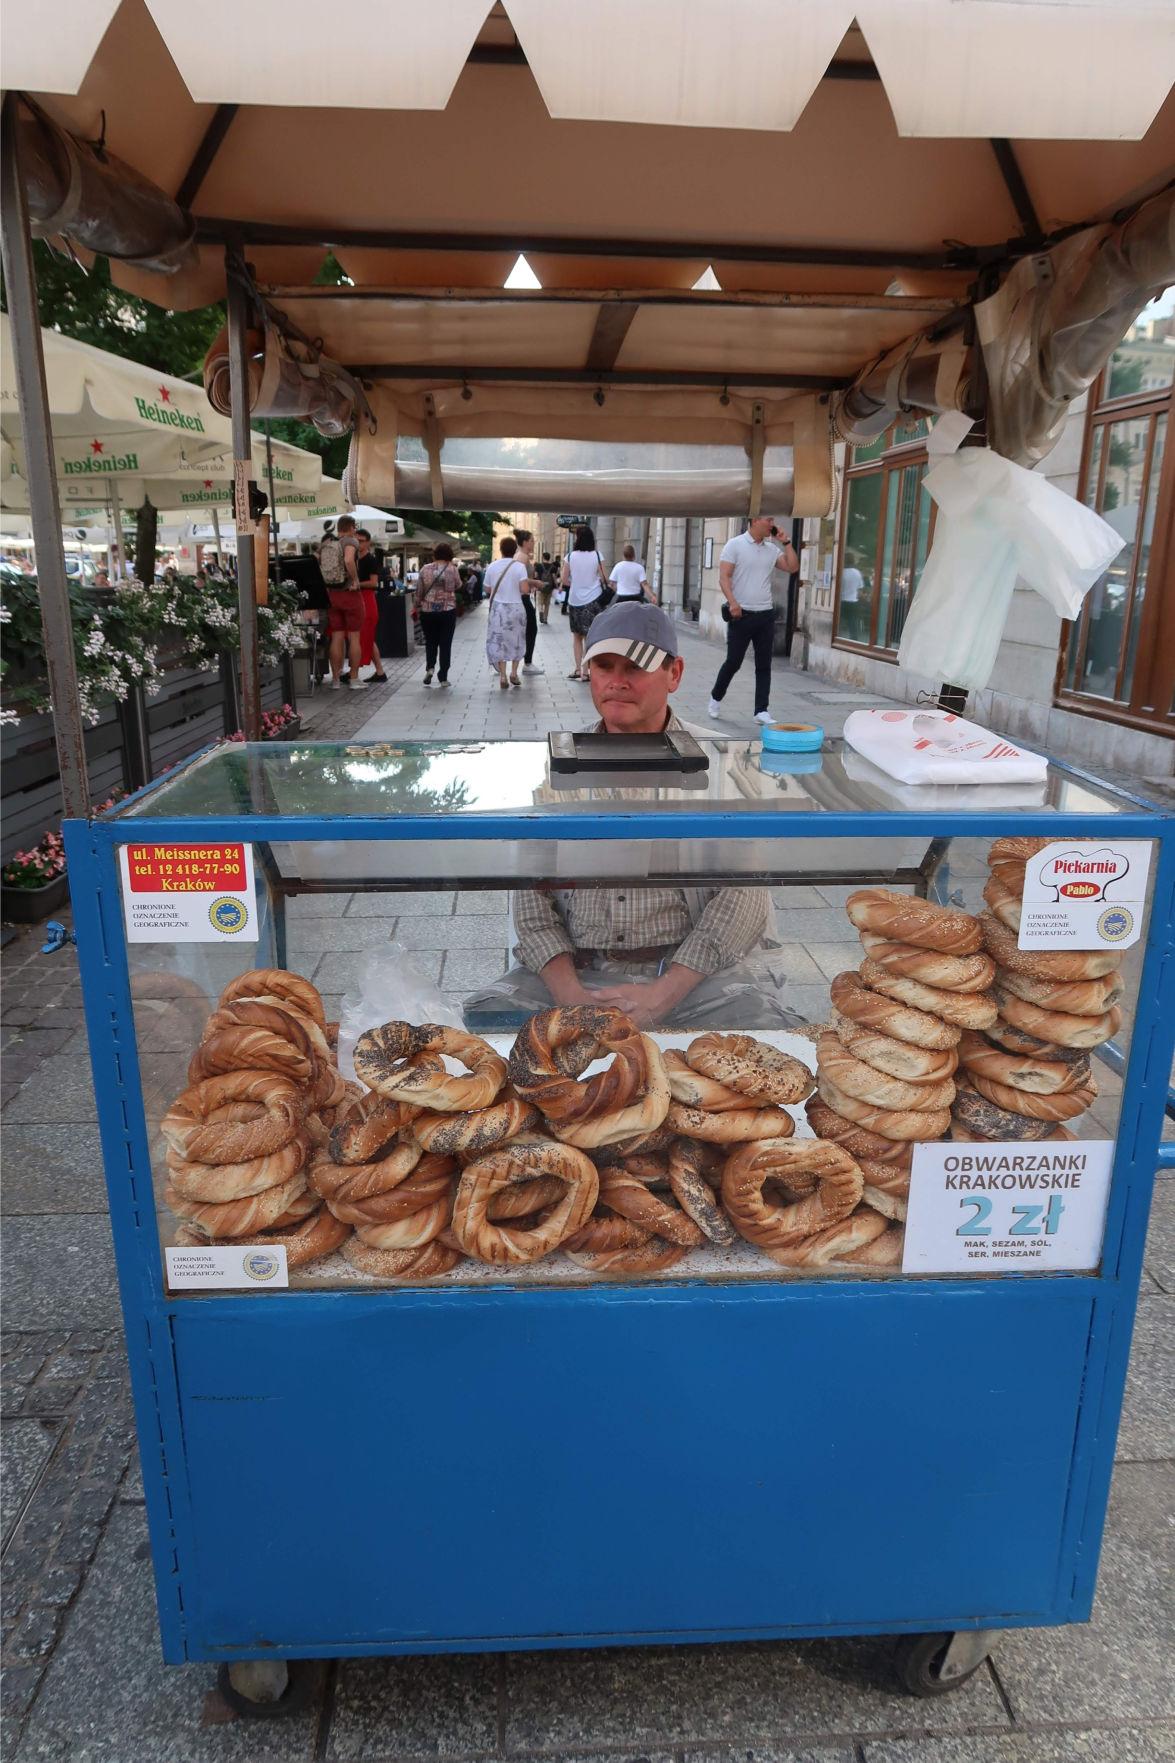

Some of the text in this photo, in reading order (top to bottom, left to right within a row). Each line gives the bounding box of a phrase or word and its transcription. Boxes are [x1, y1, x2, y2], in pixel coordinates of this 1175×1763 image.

[134, 396, 205, 433] Heineken
[133, 848, 239, 860] ul. Meissnera 24
[134, 863, 240, 875] tel. 12 418-77-90
[161, 878, 216, 891] Kraków
[1066, 885, 1094, 895] Pablo
[132, 912, 180, 920] OZNACZENIE
[133, 921, 190, 929] GEOGRAFICZNE
[943, 1154, 1087, 1172] OBWARZANKI
[945, 1173, 1082, 1190] KRAKOWSKIE
[956, 1194, 1066, 1236] 2 zł
[963, 1240, 988, 1249] MAK,
[991, 1240, 1027, 1249] SEZAM,
[992, 1250, 1042, 1258] MIESZANE
